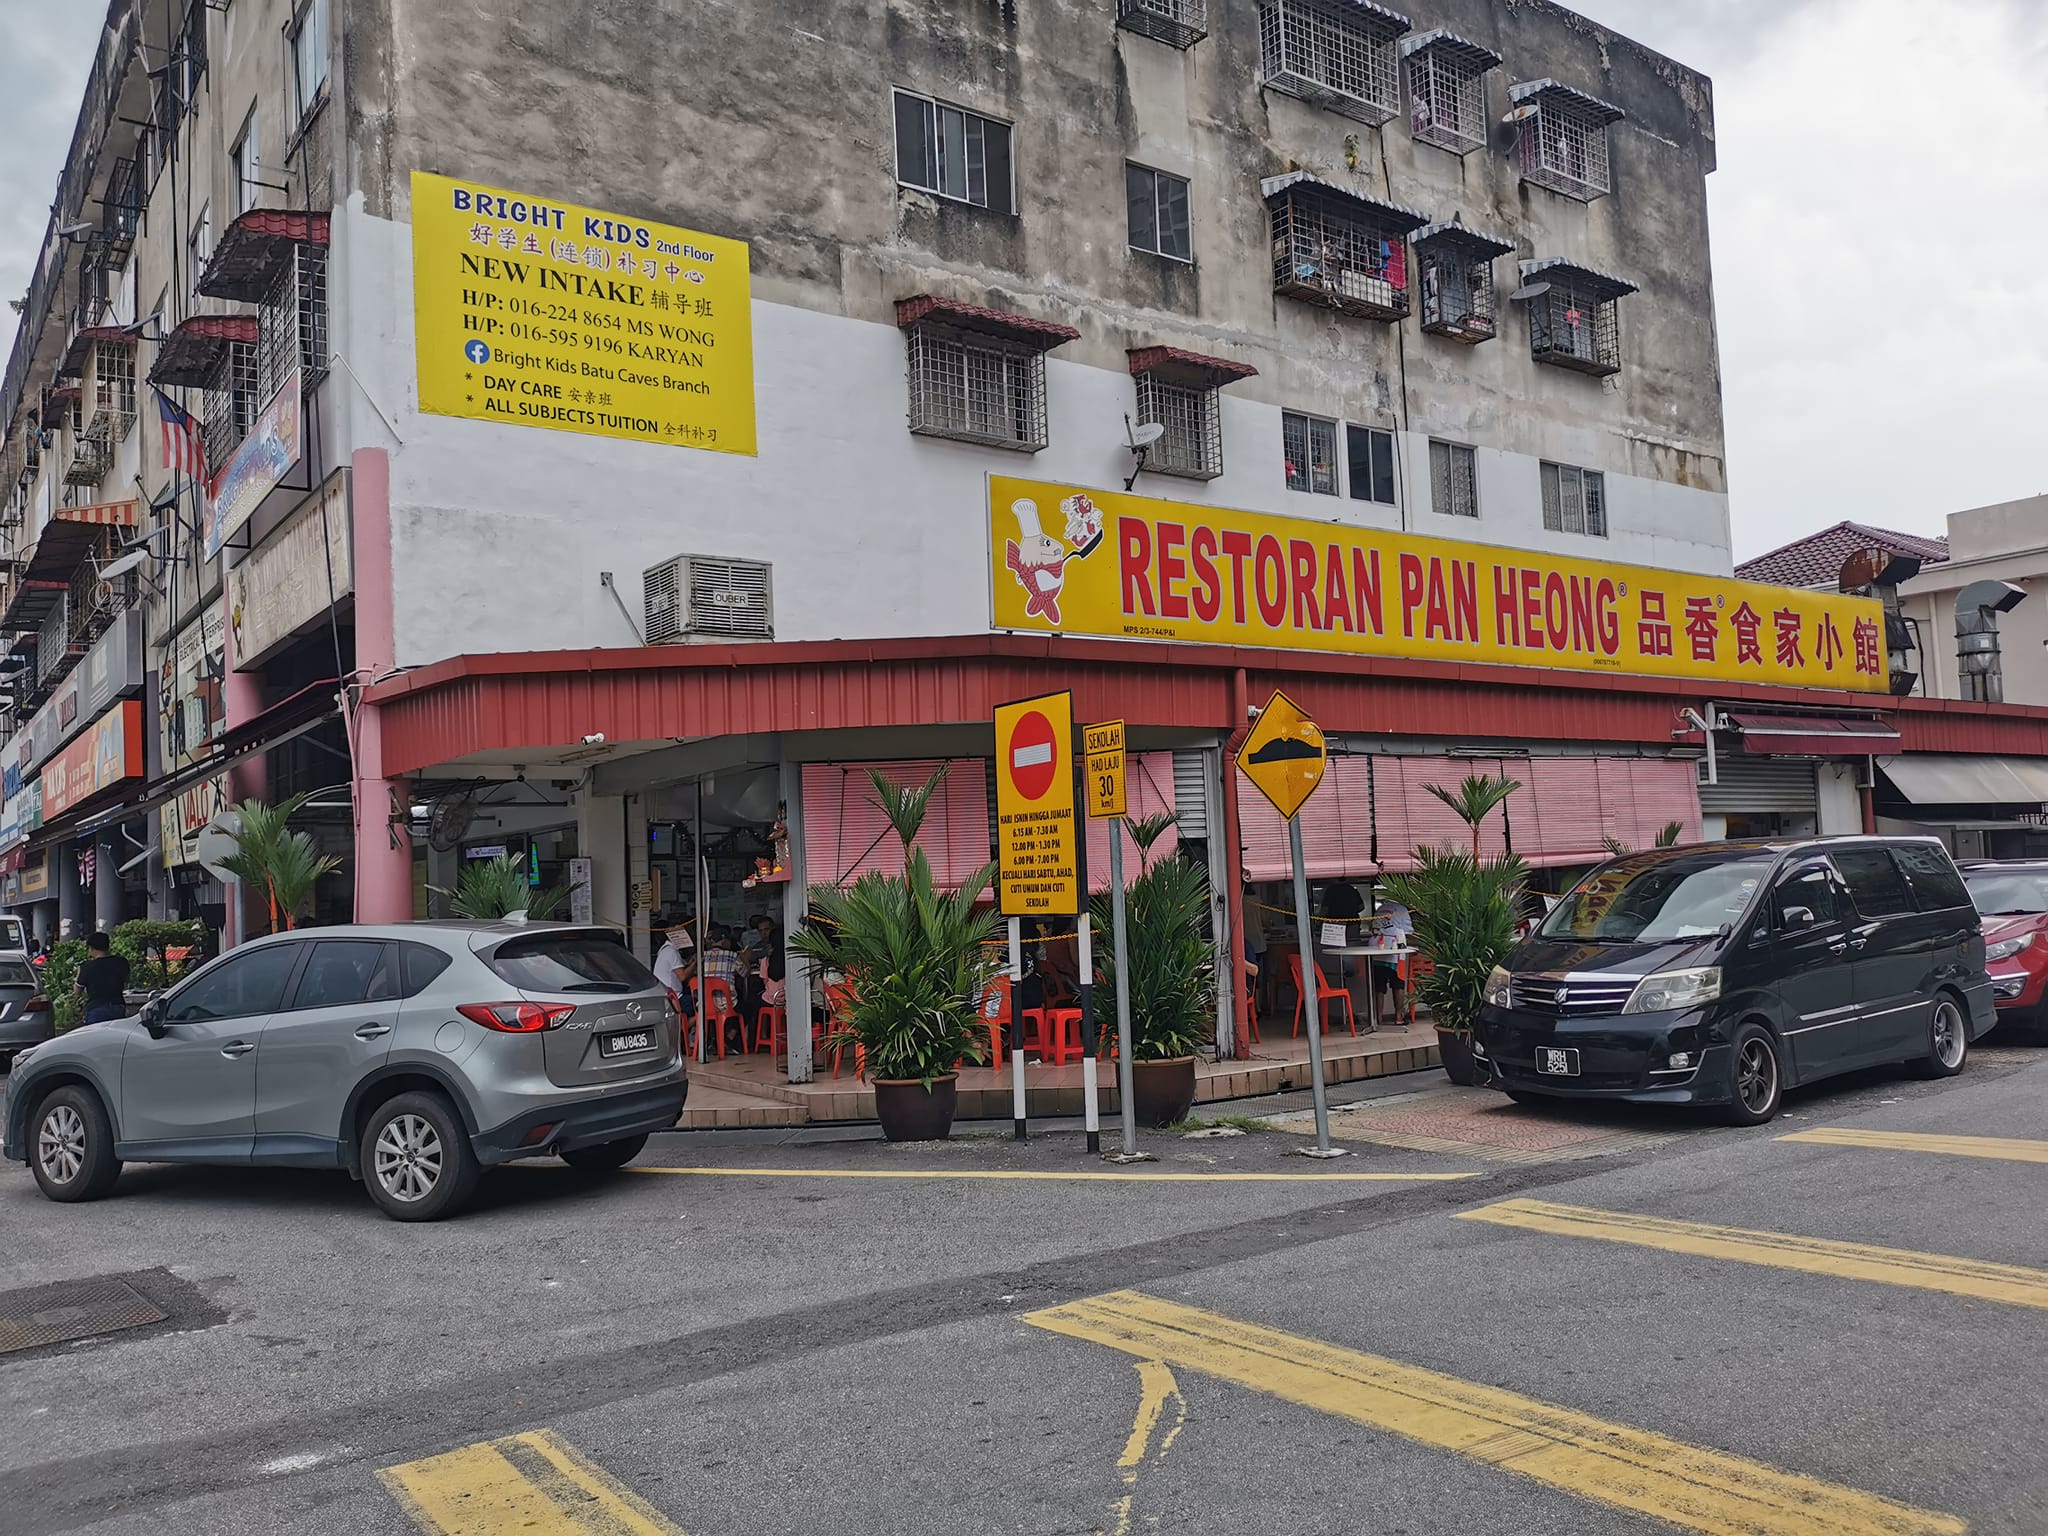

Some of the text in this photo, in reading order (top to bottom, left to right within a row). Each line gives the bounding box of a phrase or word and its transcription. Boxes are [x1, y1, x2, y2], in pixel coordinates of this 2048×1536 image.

[453, 189, 715, 262] BRIGHT KIDS 2nd Floor
[460, 253, 645, 307] NEW INTAKE
[651, 289, 714, 317] 辅导班
[463, 289, 715, 347] H/P: 016-224 8654 MS WONG
[464, 314, 703, 368] H/P: 016-595 9196 KARYAN
[494, 348, 710, 395] Bright Kids Batu Caves Branch
[484, 375, 562, 399] DAY CARE
[568, 388, 613, 406] 安亲班
[485, 397, 658, 433] ALL SUBJECTS TUITION
[664, 422, 717, 442] 全科补习
[1118, 515, 1384, 636] RESTORAN
[1399, 553, 1481, 645] PAN
[1123, 625, 1138, 634] MPS
[1088, 729, 1120, 749] SEKOLAH
[1091, 755, 1119, 772] HAD LAJU
[1099, 775, 1114, 797] 30
[1000, 808, 1072, 824] HARI ISNIN HINGGA JUMAAT
[1013, 828, 1024, 837] 6.15
[1025, 827, 1033, 836] AM
[1037, 826, 1048, 835] 7.30
[1049, 824, 1058, 834] AM
[1012, 842, 1026, 851] 12.00
[1027, 841, 1035, 850] PM
[1039, 840, 1050, 849] 1.30
[1052, 839, 1060, 848] PM
[1014, 856, 1025, 865] 6.00
[1026, 855, 1034, 864] PM
[1038, 855, 1049, 864] 7.00
[1051, 854, 1059, 863] PM
[1002, 870, 1022, 880] KECUALI
[1023, 869, 1036, 879] HARI
[1011, 883, 1065, 893] CUTI UMUM DAN CUTI
[1026, 898, 1049, 907] SEKOLAH
[1547, 1049, 1566, 1062] WRH
